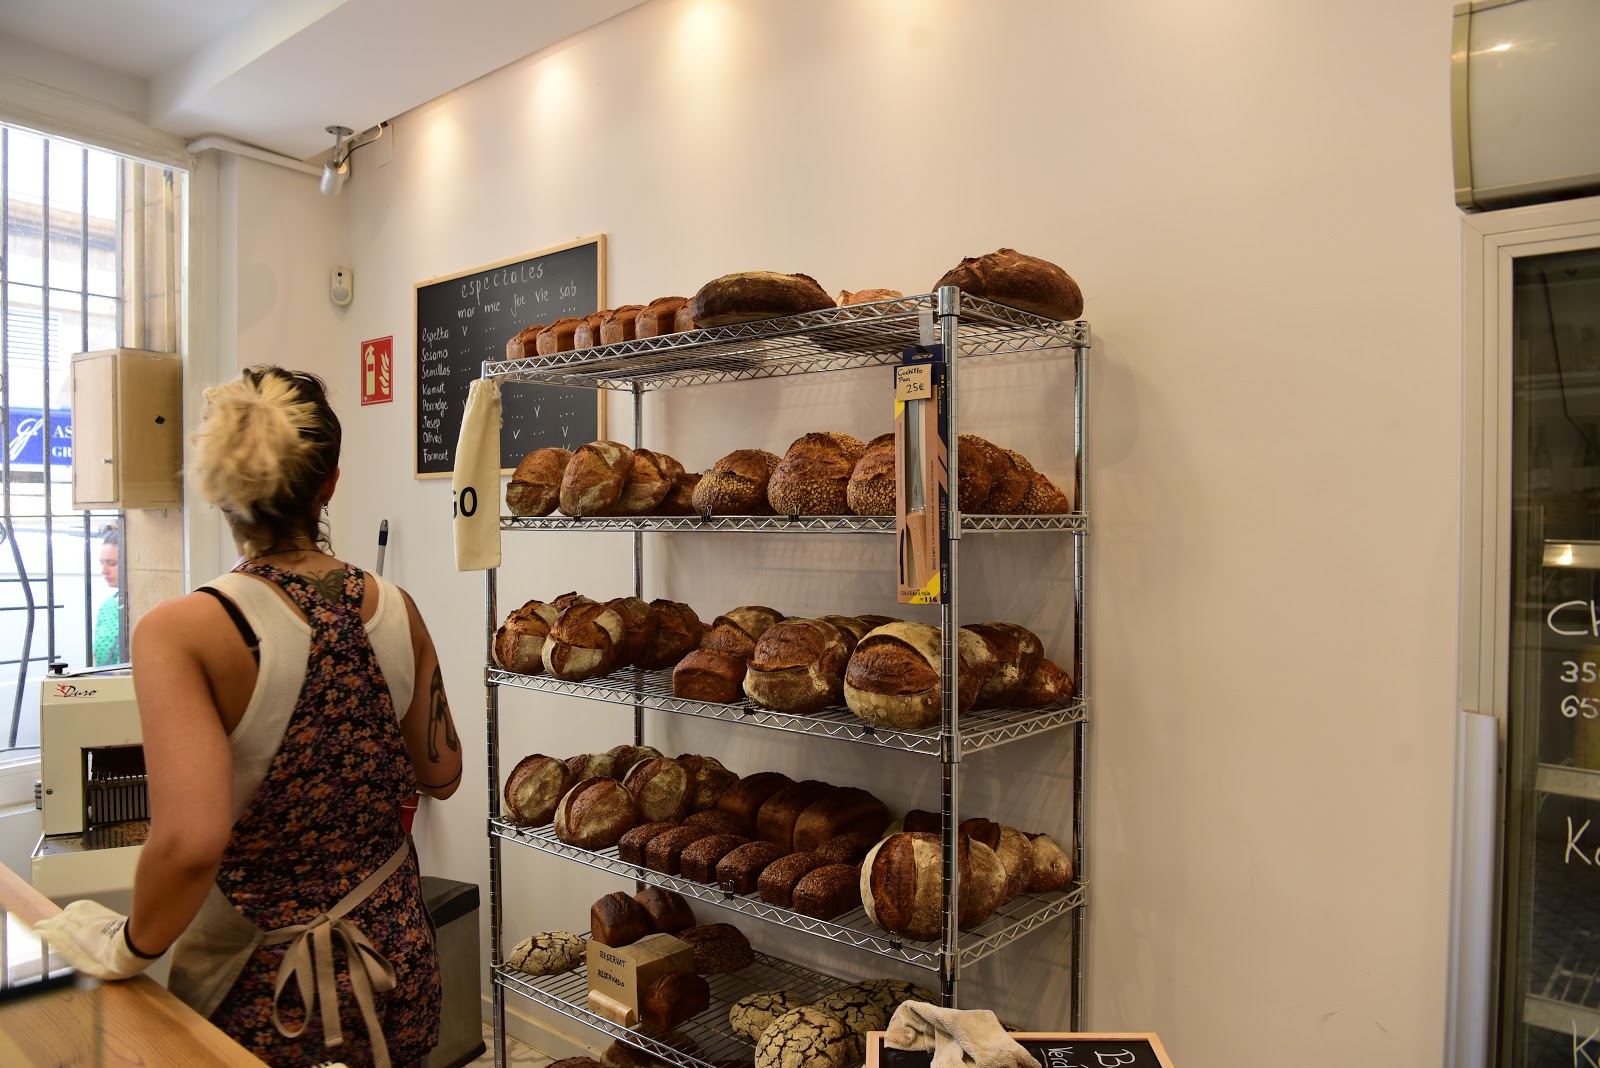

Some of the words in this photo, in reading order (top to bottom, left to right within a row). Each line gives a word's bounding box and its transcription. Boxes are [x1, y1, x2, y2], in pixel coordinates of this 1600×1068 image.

[461, 262, 544, 305] especiales
[457, 306, 475, 319] mar
[535, 288, 550, 304] vie
[559, 280, 577, 300] sab
[1560, 660, 1600, 683] 35
[64, 684, 98, 698] Duro
[599, 950, 626, 968] RESERVAT
[597, 969, 625, 988] RESERVADO
